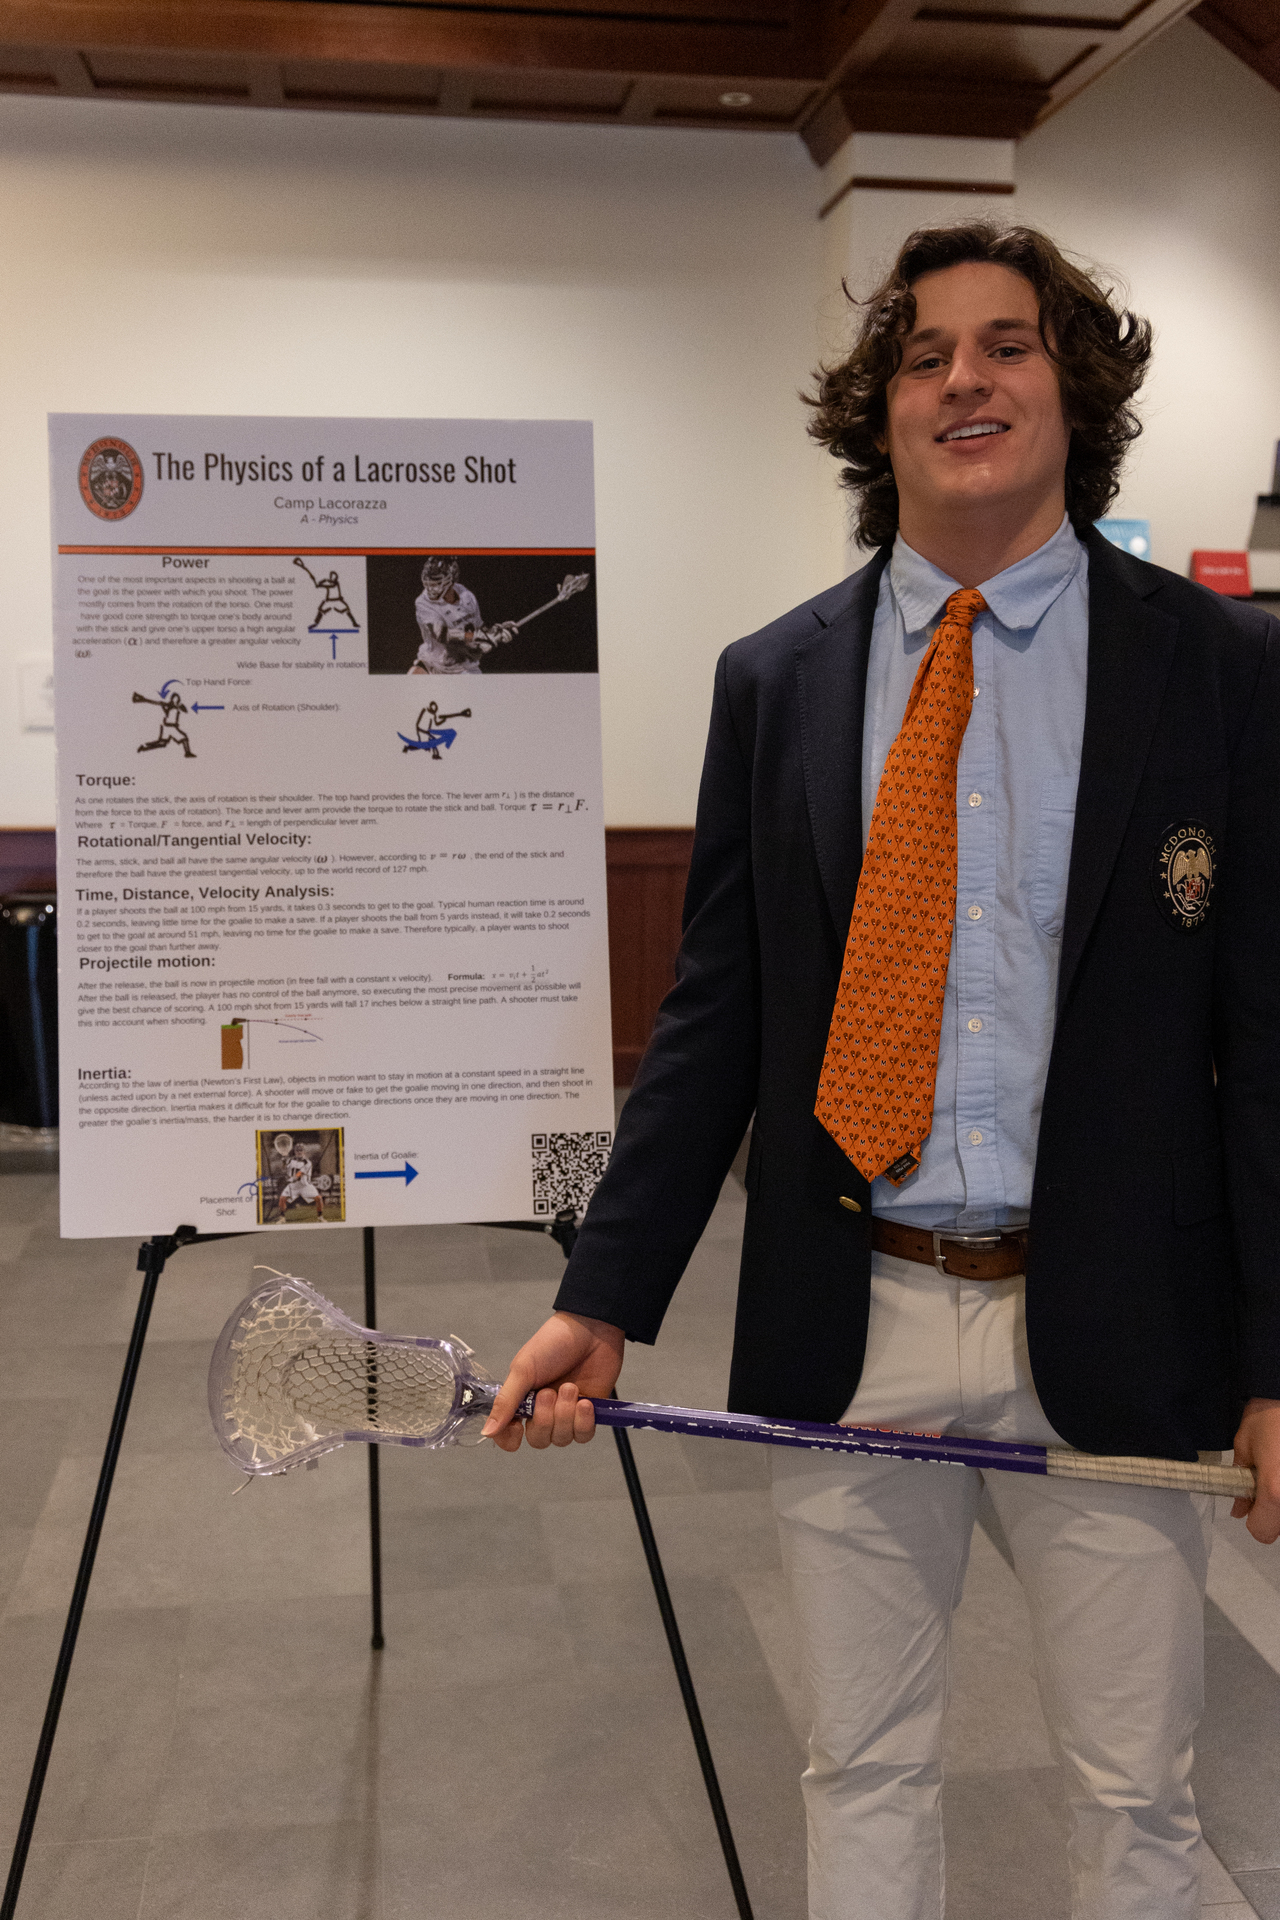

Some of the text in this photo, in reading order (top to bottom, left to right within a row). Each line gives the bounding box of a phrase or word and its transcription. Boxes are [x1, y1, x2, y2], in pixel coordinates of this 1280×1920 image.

[153, 452, 517, 486] The Physics of a Lacrosse Shot
[274, 496, 387, 511] Camp Lacorazza
[300, 514, 309, 524] A
[318, 514, 359, 526] Physics
[162, 556, 210, 569] Power
[92, 588, 110, 597] goal
[102, 613, 123, 622] good
[145, 613, 178, 622] strength
[190, 613, 216, 622] torque
[241, 613, 261, 622] body
[294, 661, 324, 670] stability
[186, 678, 201, 687] Top
[76, 774, 136, 788] Torque:
[498, 803, 526, 813] Torque
[246, 818, 271, 828] length
[283, 818, 336, 827] perpendicular
[77, 832, 312, 849] Rotational/Tangential Velocity:
[1160, 826, 1217, 864] MCDONOGH
[183, 868, 216, 878] greatest
[218, 868, 258, 877] tangential
[75, 884, 335, 903] Time, Distance, Velocity Analysis:
[91, 907, 117, 917] player
[207, 905, 225, 914] mph
[332, 902, 365, 910] seconds
[377, 902, 390, 911] get
[437, 900, 465, 910] Typical
[496, 899, 527, 907] reaction
[80, 955, 216, 972] Projectile motion:
[448, 972, 486, 982] Formula:
[111, 1018, 144, 1026] account
[78, 1067, 132, 1080] Inertia:
[94, 1106, 129, 1116] opposite
[170, 1103, 196, 1112] Inertia
[198, 1102, 225, 1111] makes
[234, 1101, 262, 1110] difficult
[305, 1099, 329, 1109] goalie
[341, 1098, 371, 1108] change
[373, 1097, 411, 1105] directions
[435, 1095, 452, 1105] they
[469, 1094, 498, 1104] moving
[78, 1119, 108, 1129] greater
[227, 1114, 254, 1122] harder
[282, 1112, 312, 1122] change
[354, 1153, 379, 1161] Inertia
[200, 1196, 244, 1204] Placement
